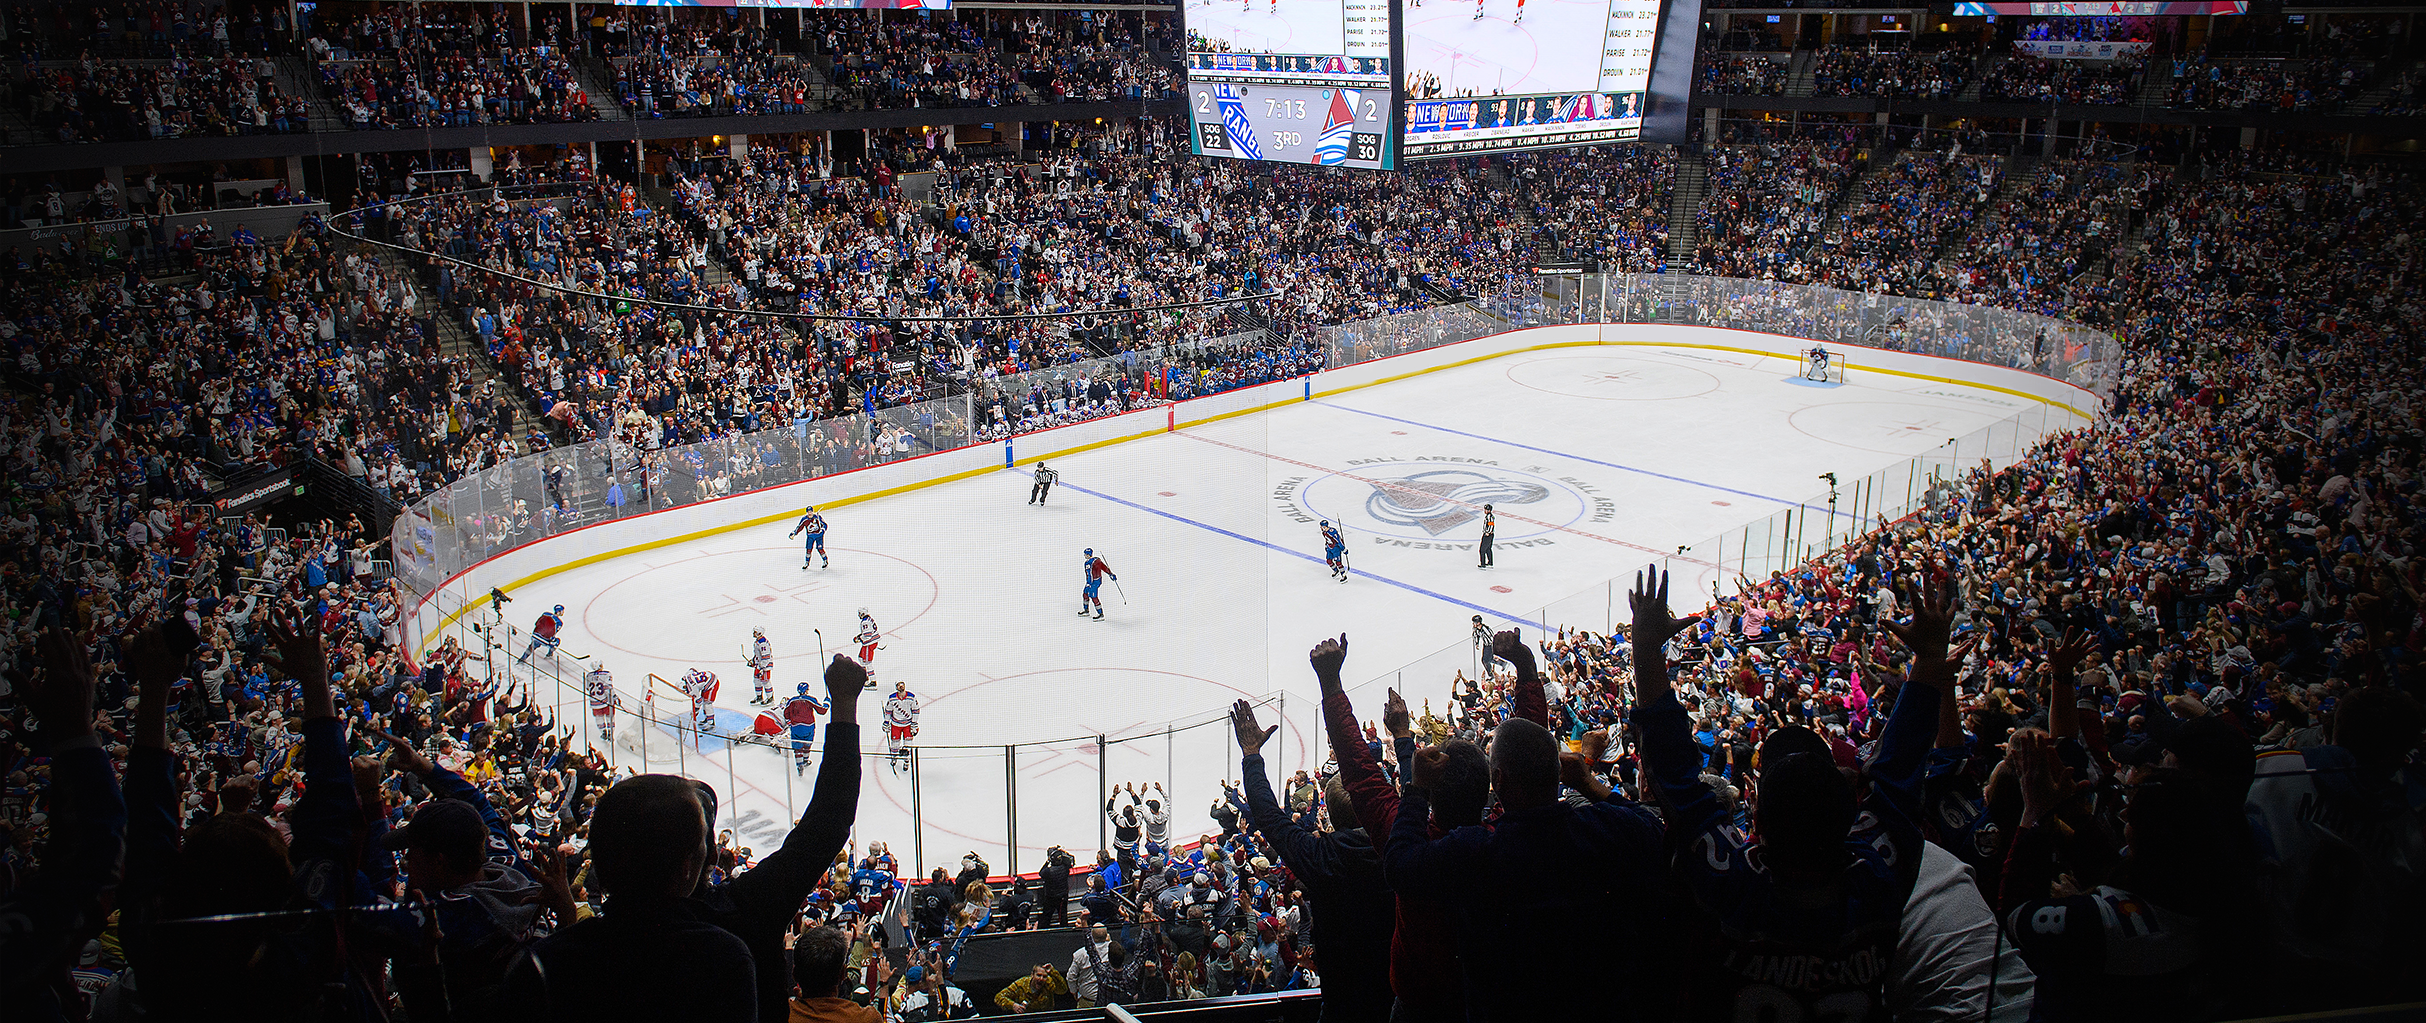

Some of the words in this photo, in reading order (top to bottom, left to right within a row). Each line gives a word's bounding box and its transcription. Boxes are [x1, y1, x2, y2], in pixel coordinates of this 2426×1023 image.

[1197, 91, 1210, 114] 2
[1265, 98, 1306, 120] 7:13
[1521, 101, 1526, 110] 8
[1365, 99, 1377, 122] 2
[1204, 124, 1220, 134] SOG
[1206, 136, 1221, 148] 22
[1273, 131, 1302, 151] 3RD
[1357, 134, 1376, 145] SOG
[1459, 142, 1472, 150] 9.35
[1472, 140, 1484, 149] MPH
[1500, 139, 1512, 147] MPH
[1358, 146, 1376, 160] 30
[1440, 143, 1454, 152] MPH
[52, 202, 59, 211] 8
[1347, 456, 1405, 466] BALL
[1415, 455, 1499, 466] ARENA
[226, 492, 255, 510] Fanatics
[254, 478, 291, 498] Sportsbook
[1274, 476, 1308, 501] ARENA
[1558, 476, 1601, 494] BALL
[1589, 496, 1616, 523] ARENA
[1278, 503, 1316, 524] BALL
[1375, 537, 1474, 551] ARENA
[589, 682, 605, 696] 23
[861, 886, 871, 903] 8
[2031, 905, 2067, 935] 8
